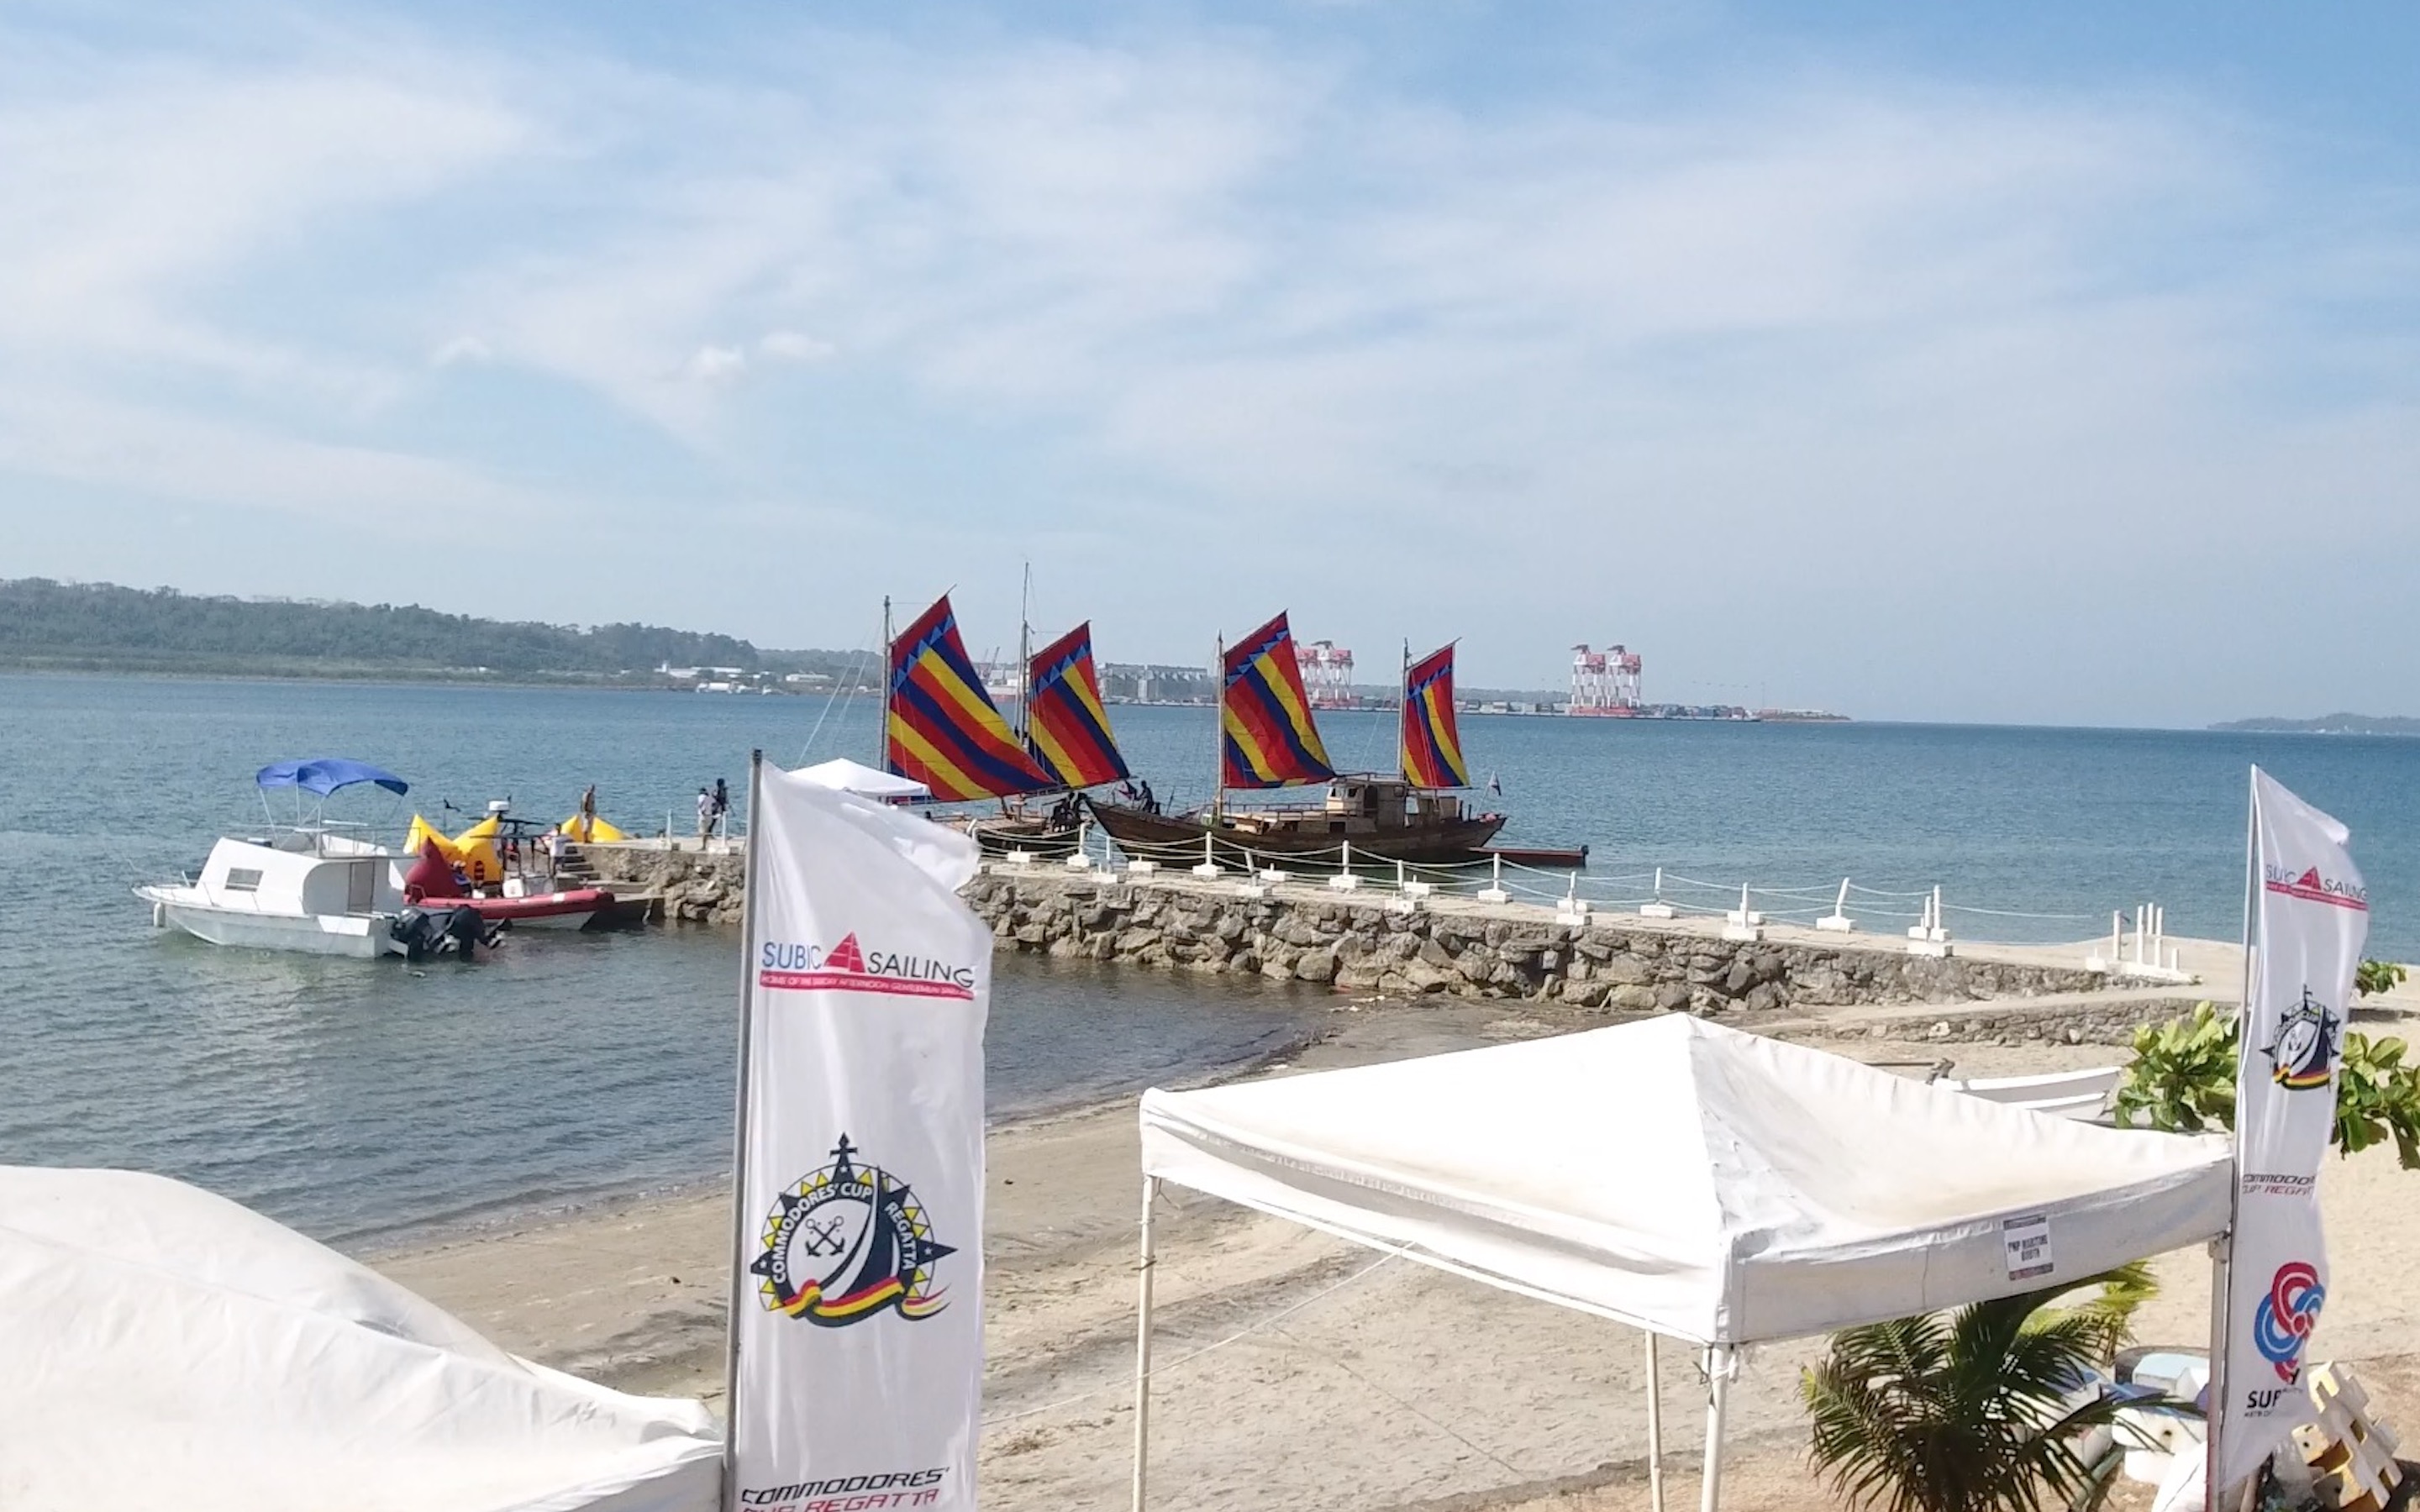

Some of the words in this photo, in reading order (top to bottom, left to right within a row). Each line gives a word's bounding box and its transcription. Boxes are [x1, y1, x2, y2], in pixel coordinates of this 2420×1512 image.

[761, 942, 822, 971] SUBIC
[867, 952, 976, 988] SAILING
[840, 1181, 874, 1200] CUP
[883, 1201, 917, 1271] REGATTA
